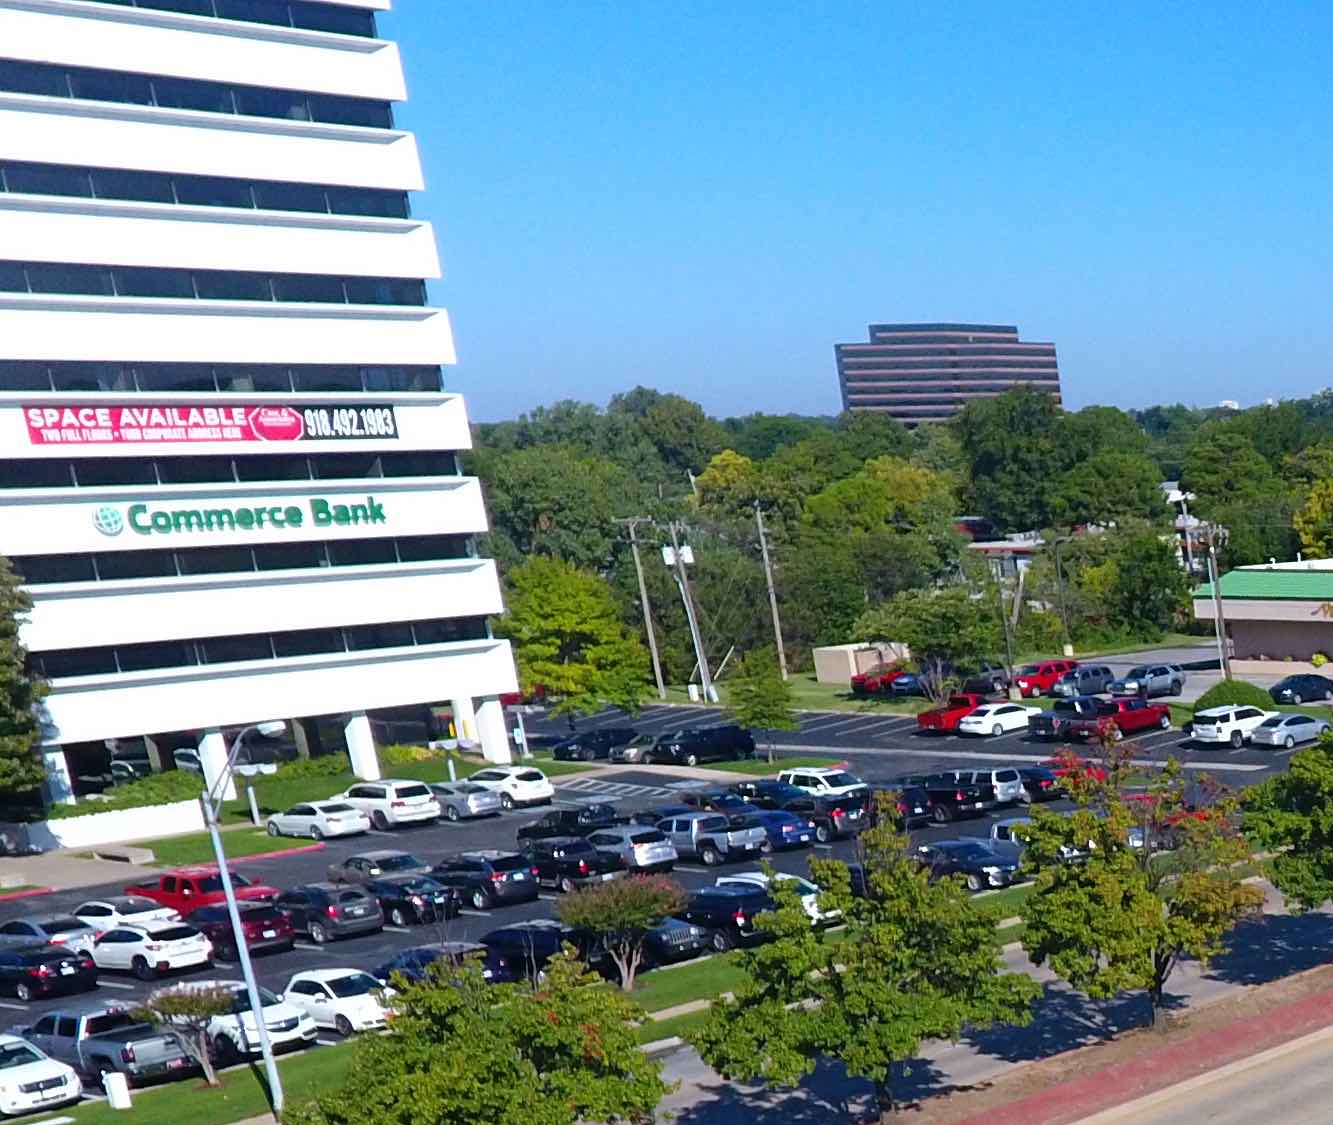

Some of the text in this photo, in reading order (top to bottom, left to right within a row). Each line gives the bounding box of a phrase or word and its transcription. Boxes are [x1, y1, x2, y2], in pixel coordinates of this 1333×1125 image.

[28, 407, 247, 427] SPACE AVAILABLE
[304, 408, 395, 436] 918.492.1983
[127, 496, 386, 534] Commerce Bank
